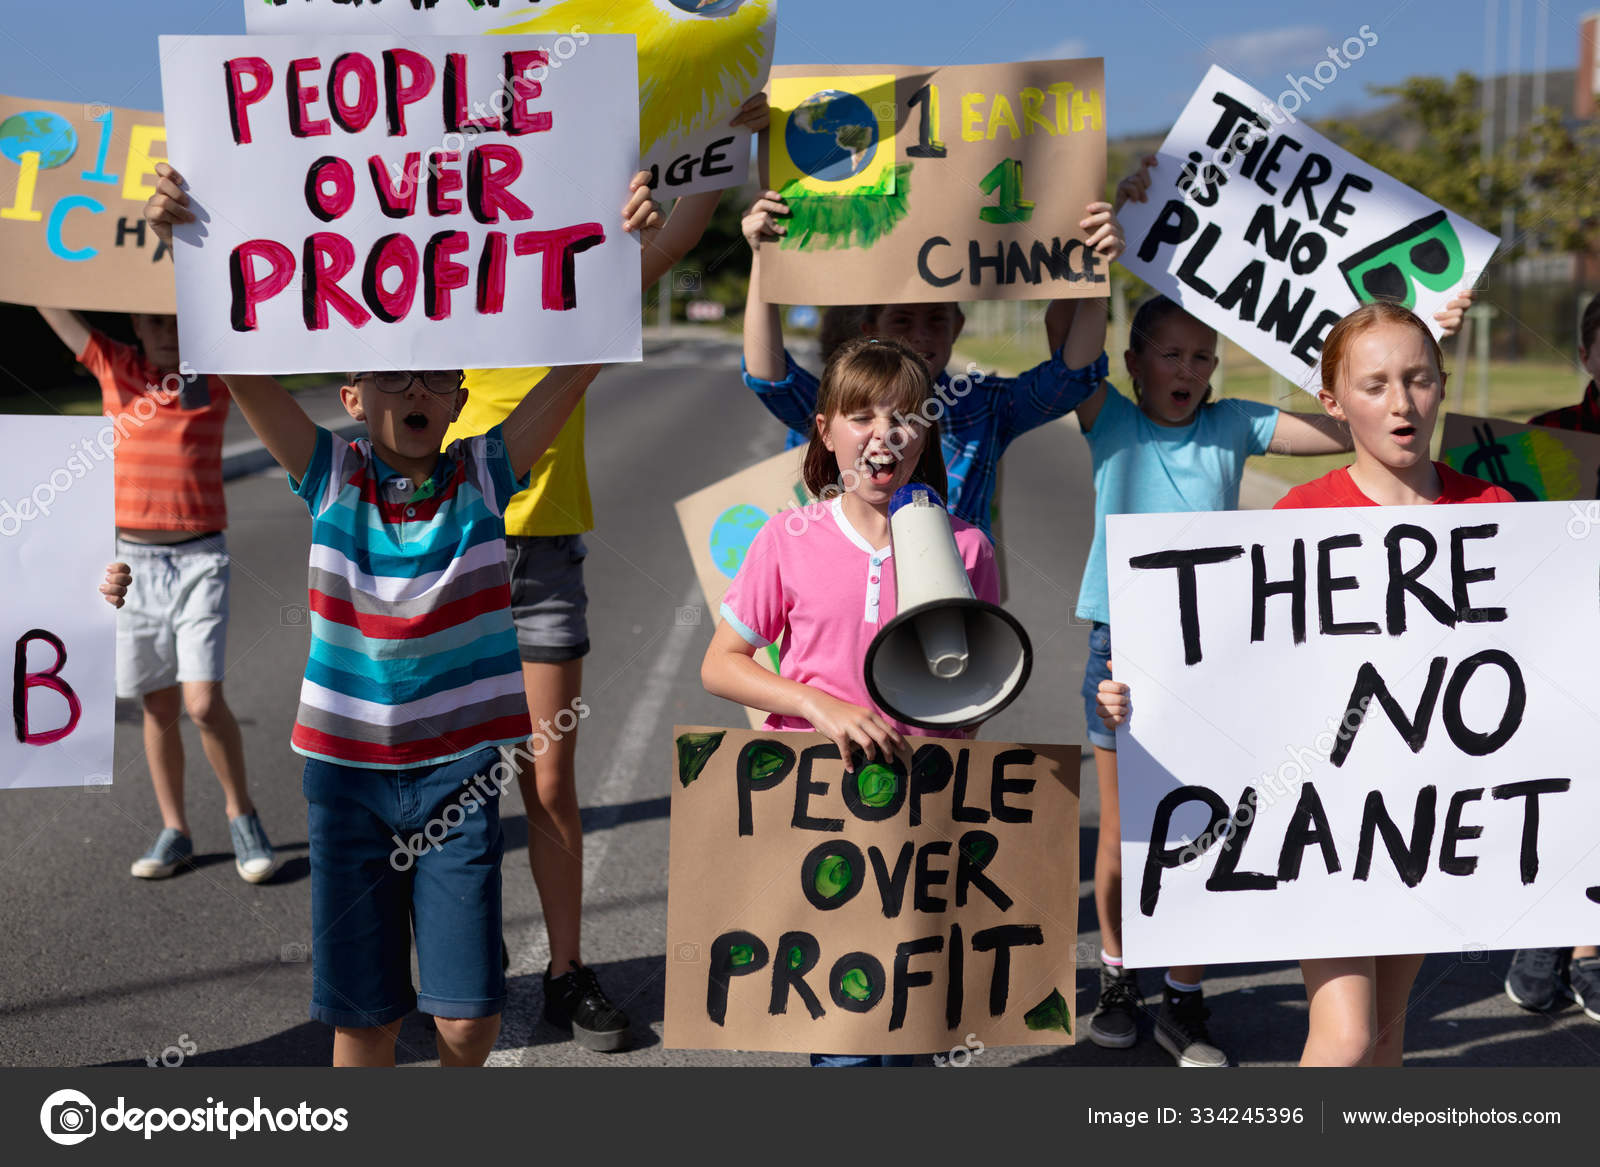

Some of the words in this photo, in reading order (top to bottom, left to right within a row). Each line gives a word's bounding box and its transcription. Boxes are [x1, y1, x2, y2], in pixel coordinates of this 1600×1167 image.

[224, 48, 553, 145] PEOPLE
[907, 83, 947, 158] 1
[961, 81, 1102, 143] EARTH
[304, 144, 534, 225] OVER
[978, 156, 1036, 225] 1
[1212, 92, 1373, 237] THERE
[229, 222, 606, 332] PROFIT
[917, 236, 1106, 288] CHANCE
[1243, 203, 1328, 276] NO
[1337, 209, 1466, 310] B
[1129, 523, 1508, 666] THERE
[13, 628, 82, 746] B
[1330, 649, 1527, 767] NO
[736, 738, 1038, 836] PEOPLE
[801, 830, 1014, 918] OVER
[1140, 778, 1571, 917] PLANET
[707, 923, 1044, 1032] PROFIT
